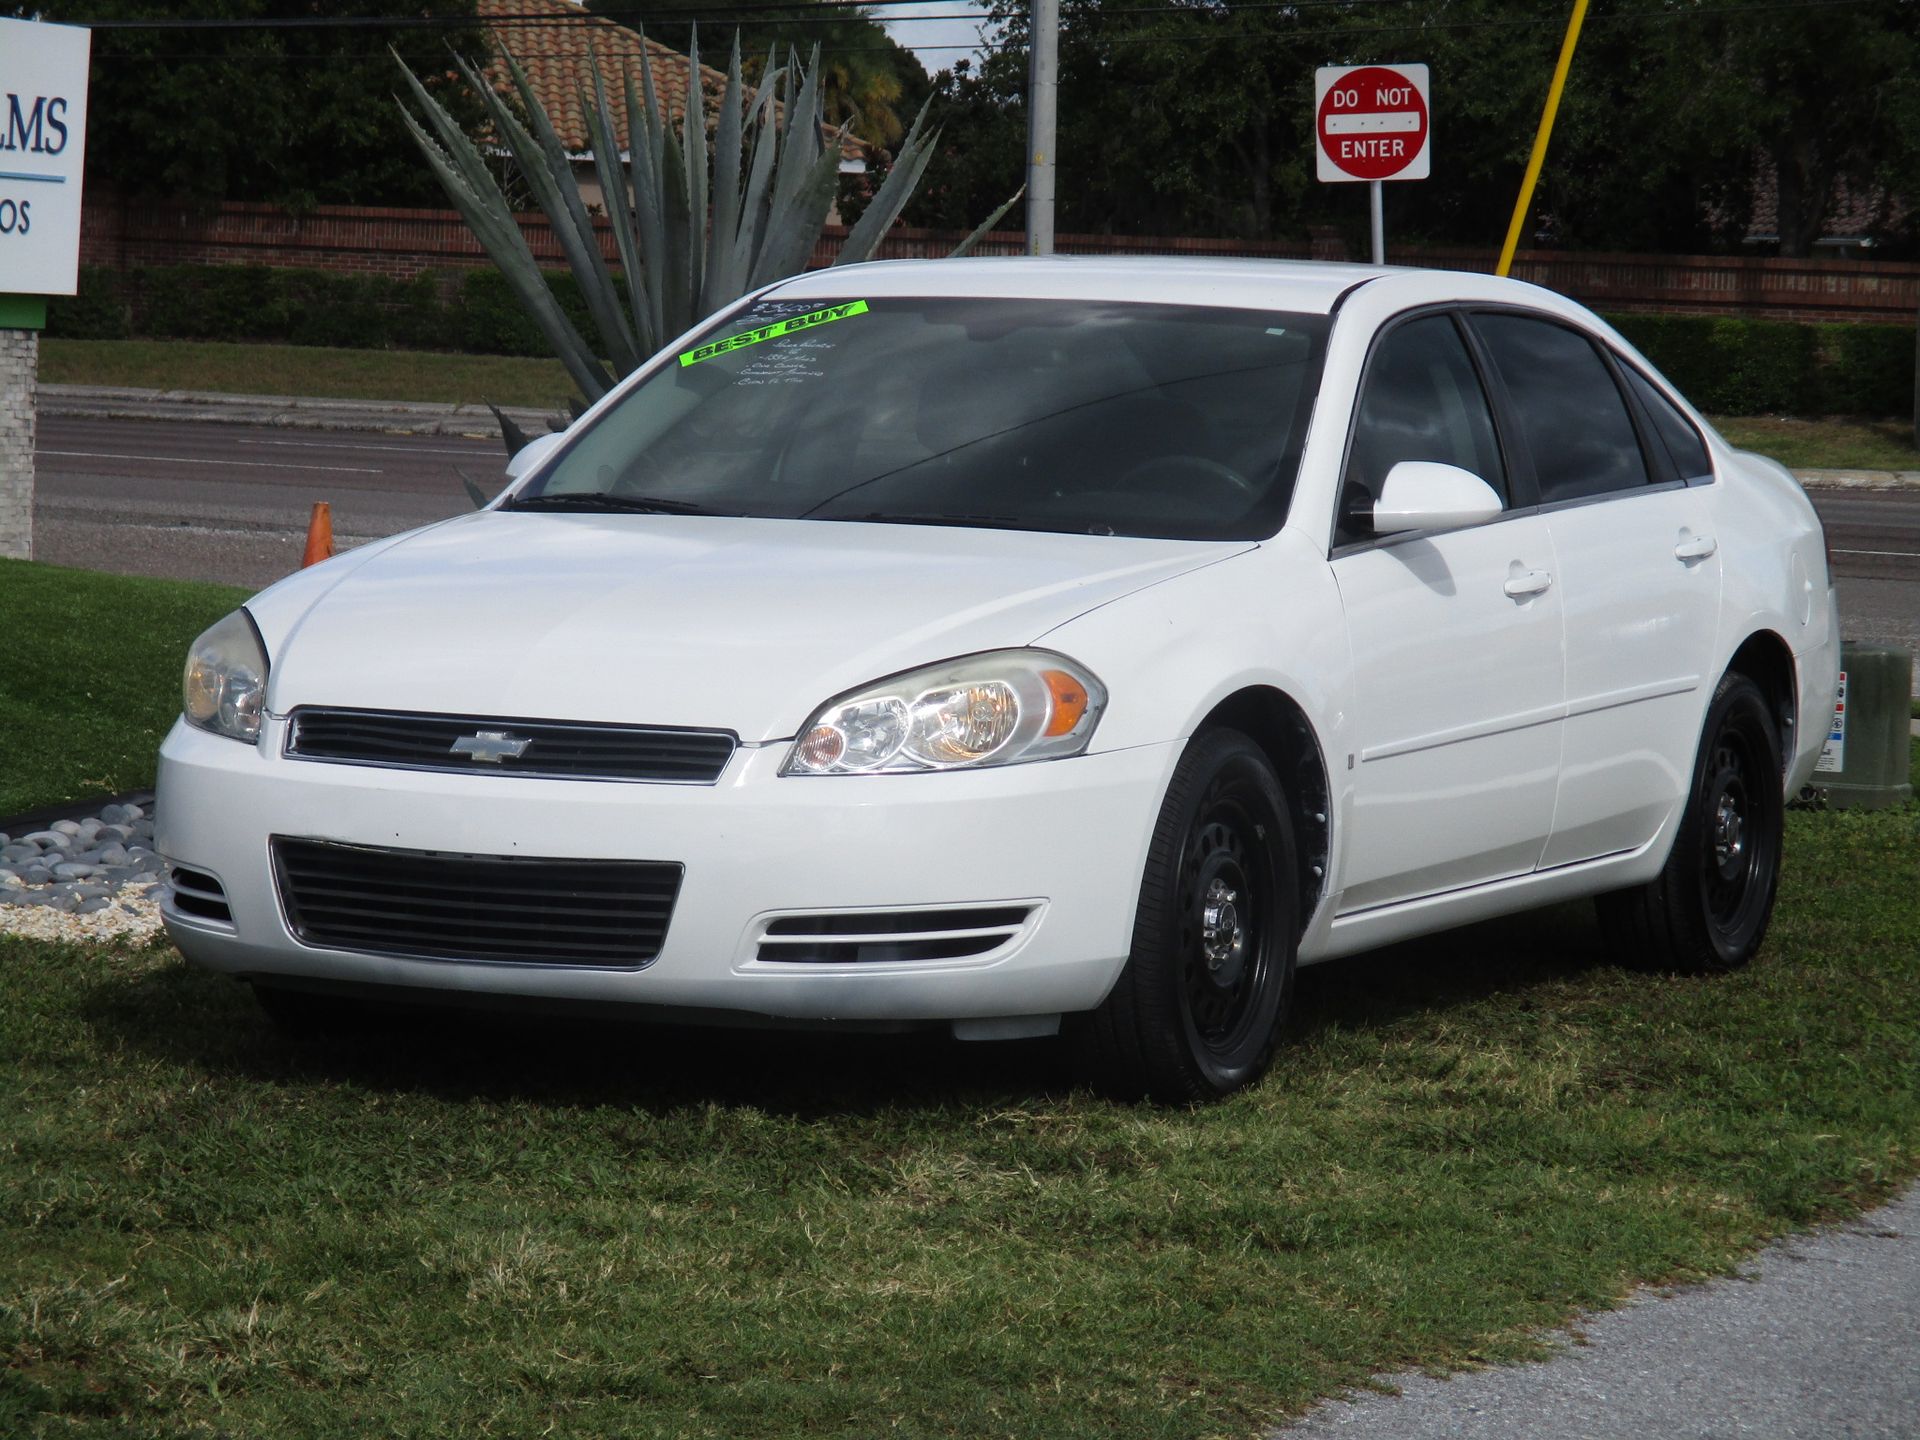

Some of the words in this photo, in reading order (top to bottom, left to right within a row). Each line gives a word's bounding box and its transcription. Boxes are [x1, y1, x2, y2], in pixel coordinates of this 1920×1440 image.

[1333, 89, 1359, 108] DO
[1376, 87, 1412, 106] NOT
[0, 93, 68, 155] MS
[1341, 139, 1405, 159] ENTER
[692, 326, 777, 361] BEST
[784, 303, 857, 333] BUY
